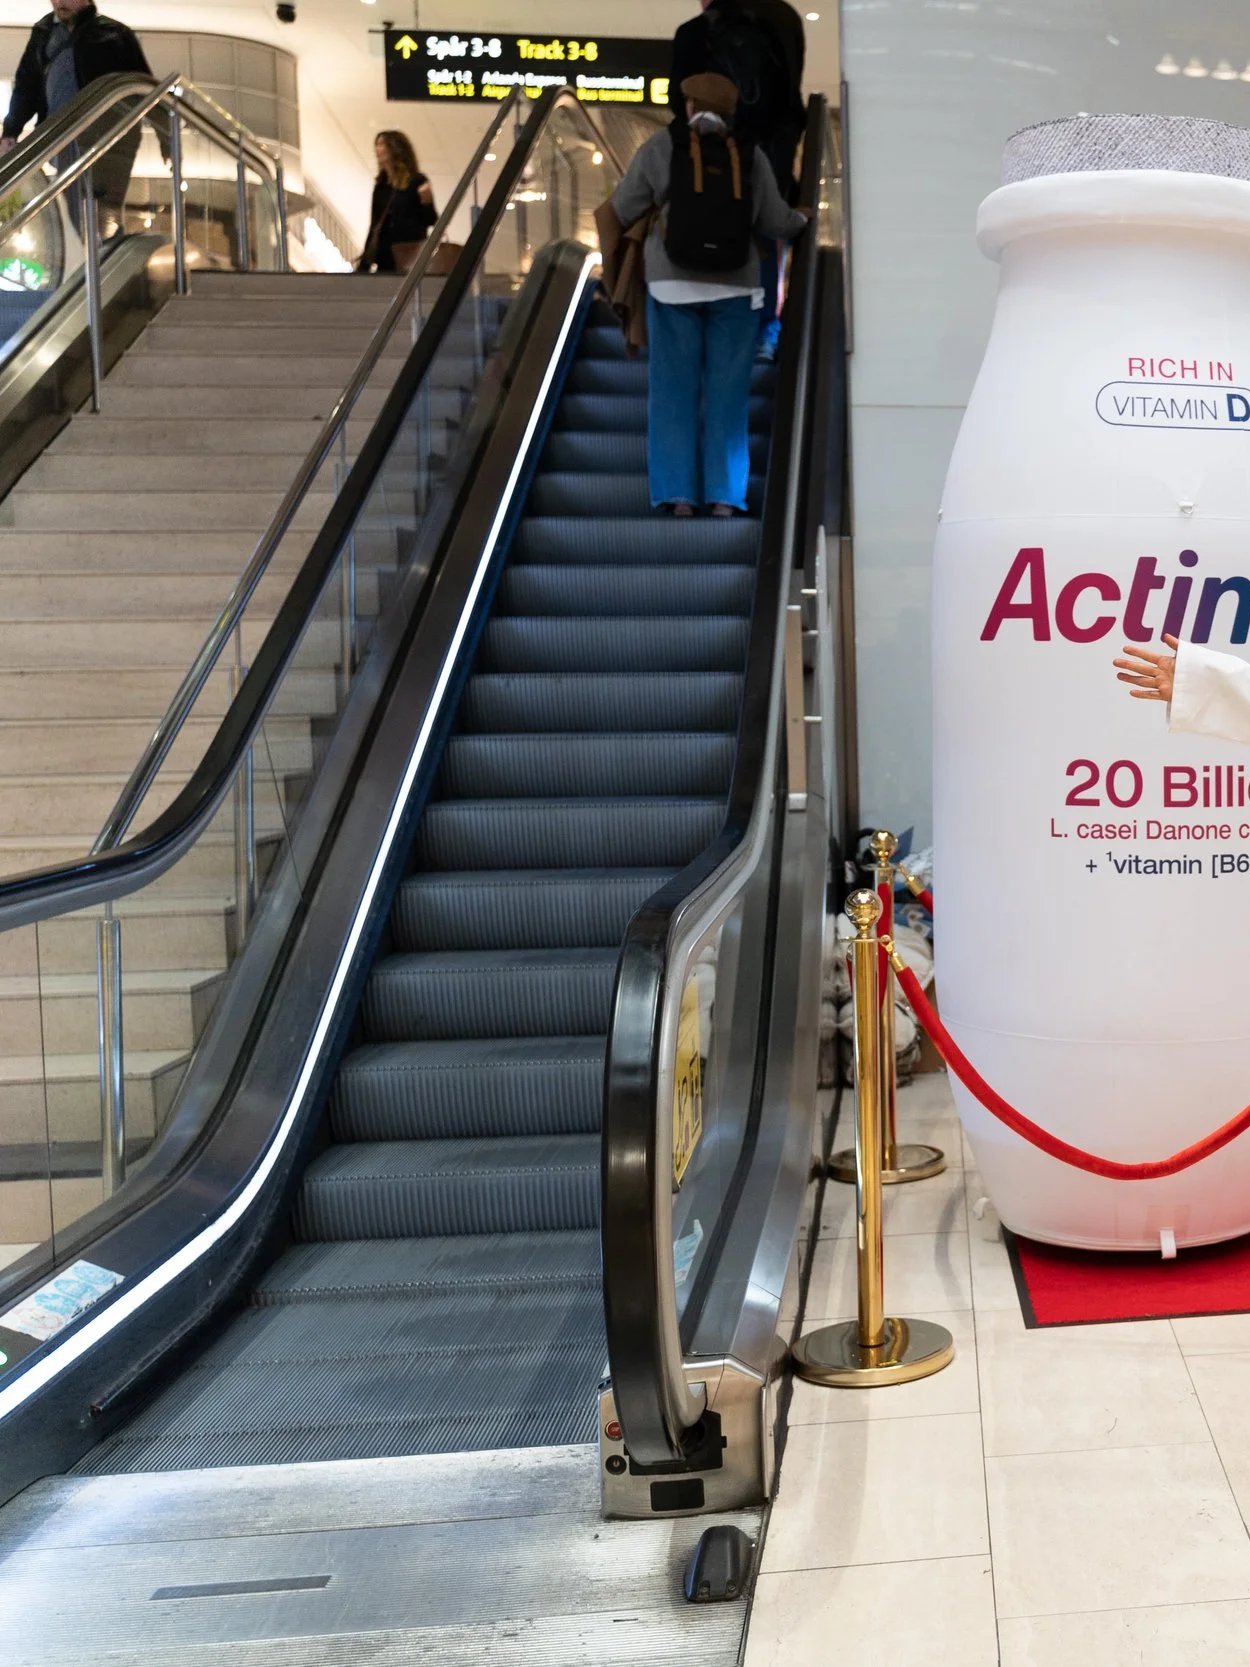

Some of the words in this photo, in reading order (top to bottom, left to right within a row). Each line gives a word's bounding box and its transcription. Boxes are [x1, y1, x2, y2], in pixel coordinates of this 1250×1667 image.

[426, 35, 468, 60] Spår
[470, 37, 502, 58] 3-8
[516, 39, 565, 60] Track
[567, 41, 598, 61] 3-8
[1127, 357, 1198, 380] RICH
[1209, 361, 1233, 382] IN
[1112, 395, 1218, 420] VITAMIN
[1226, 393, 1250, 422] D
[1065, 759, 1143, 808] 20
[1051, 818, 1068, 838] L.
[1077, 820, 1137, 839] casei
[1146, 820, 1232, 840] Danone
